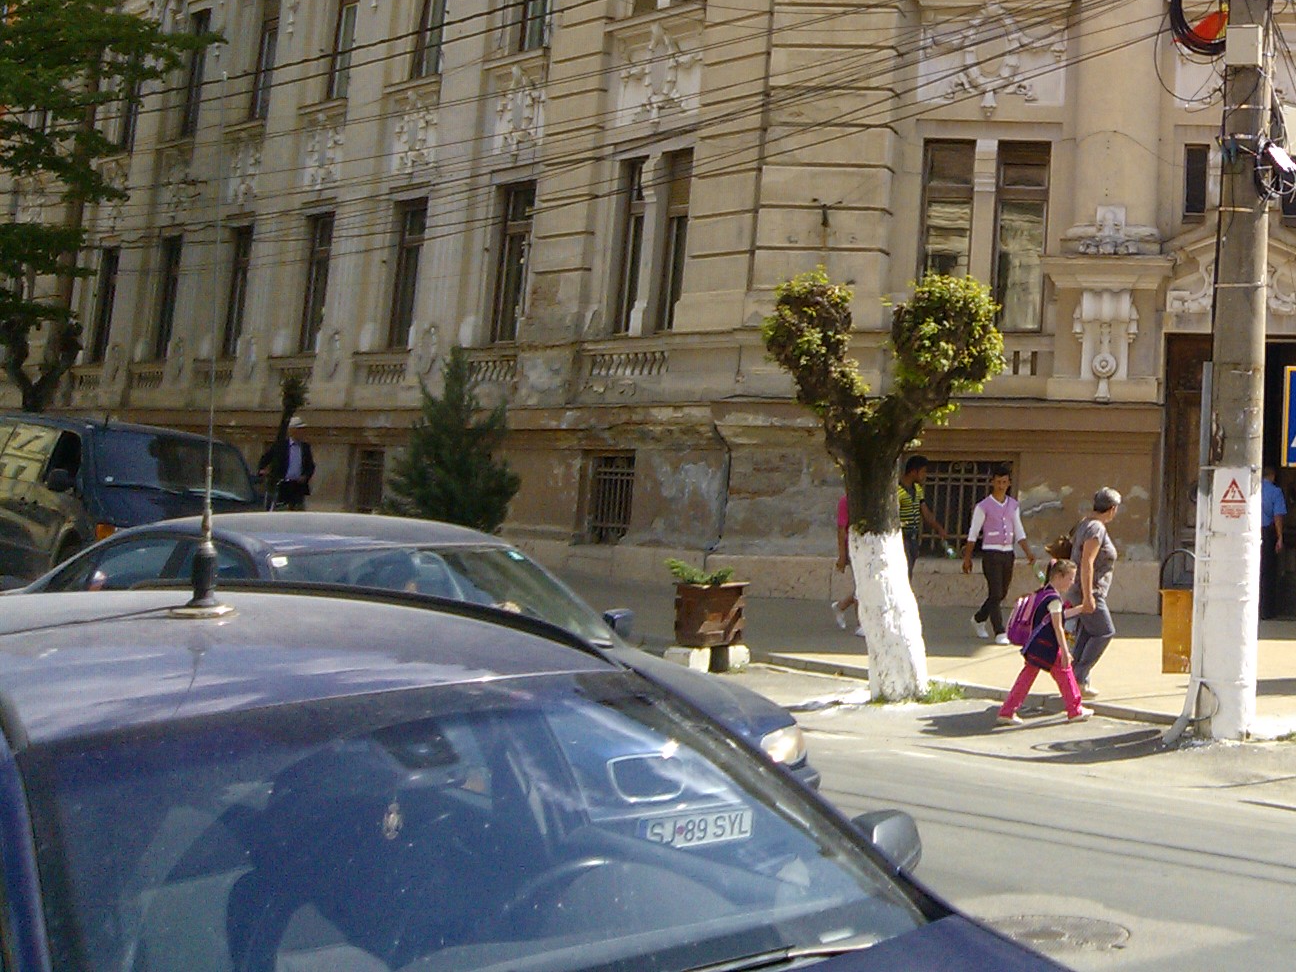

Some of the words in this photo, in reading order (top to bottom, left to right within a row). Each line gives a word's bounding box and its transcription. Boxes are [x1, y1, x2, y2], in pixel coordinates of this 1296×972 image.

[651, 820, 677, 843] SJ
[684, 818, 707, 841] 89
[713, 812, 749, 837] SYL
